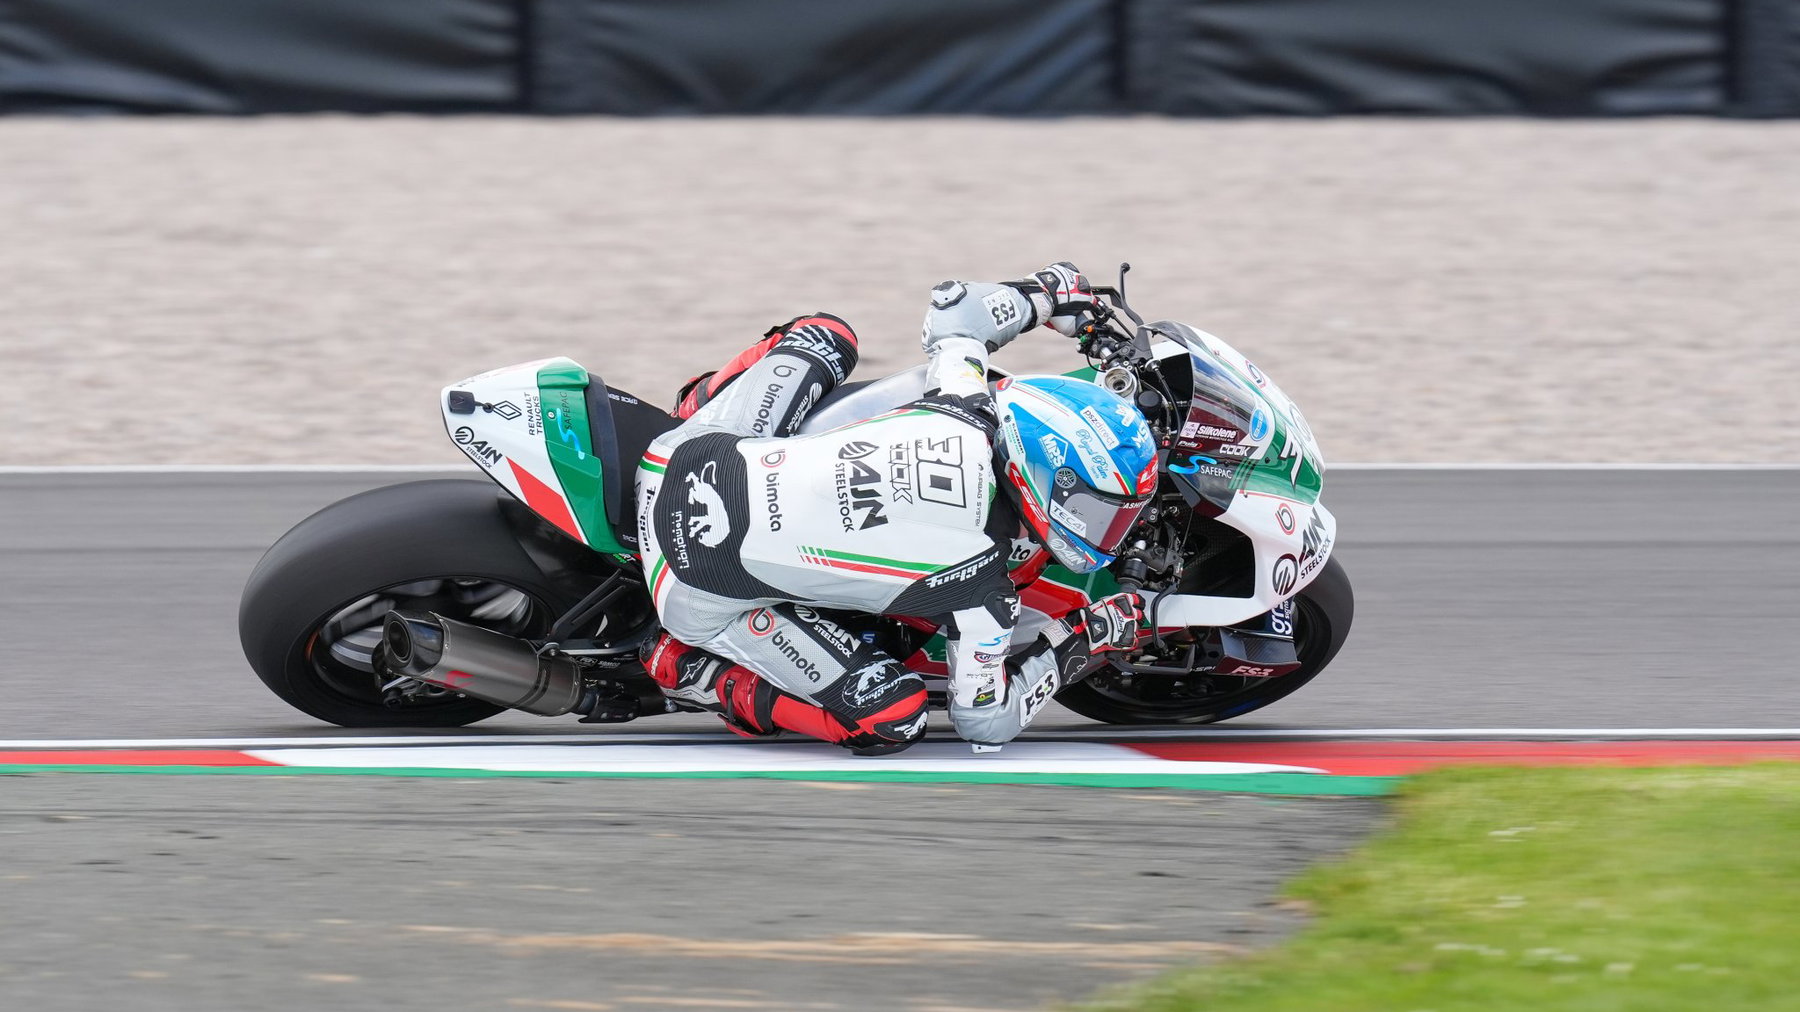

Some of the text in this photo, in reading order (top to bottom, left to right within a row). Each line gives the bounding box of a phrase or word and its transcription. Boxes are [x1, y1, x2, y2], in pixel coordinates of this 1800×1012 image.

[991, 300, 1016, 326] FS3
[524, 391, 535, 436] RENAULT
[532, 395, 543, 435] TRUCKS
[559, 391, 572, 431] SAFEPAC
[752, 383, 783, 434] bimota
[1197, 425, 1237, 439] Silkolene
[1219, 443, 1251, 457] COOK
[465, 446, 493, 470] STEELSTOCK
[1200, 465, 1232, 479] SAFEPAC
[766, 472, 783, 532] bimota
[834, 462, 855, 533] STEELSTOCK
[1300, 533, 1331, 580] STEELSTOCK
[771, 630, 822, 683] bimota
[813, 623, 853, 659] STEELSTOCK
[1231, 665, 1274, 677] FS3
[1024, 673, 1055, 717] FS3
